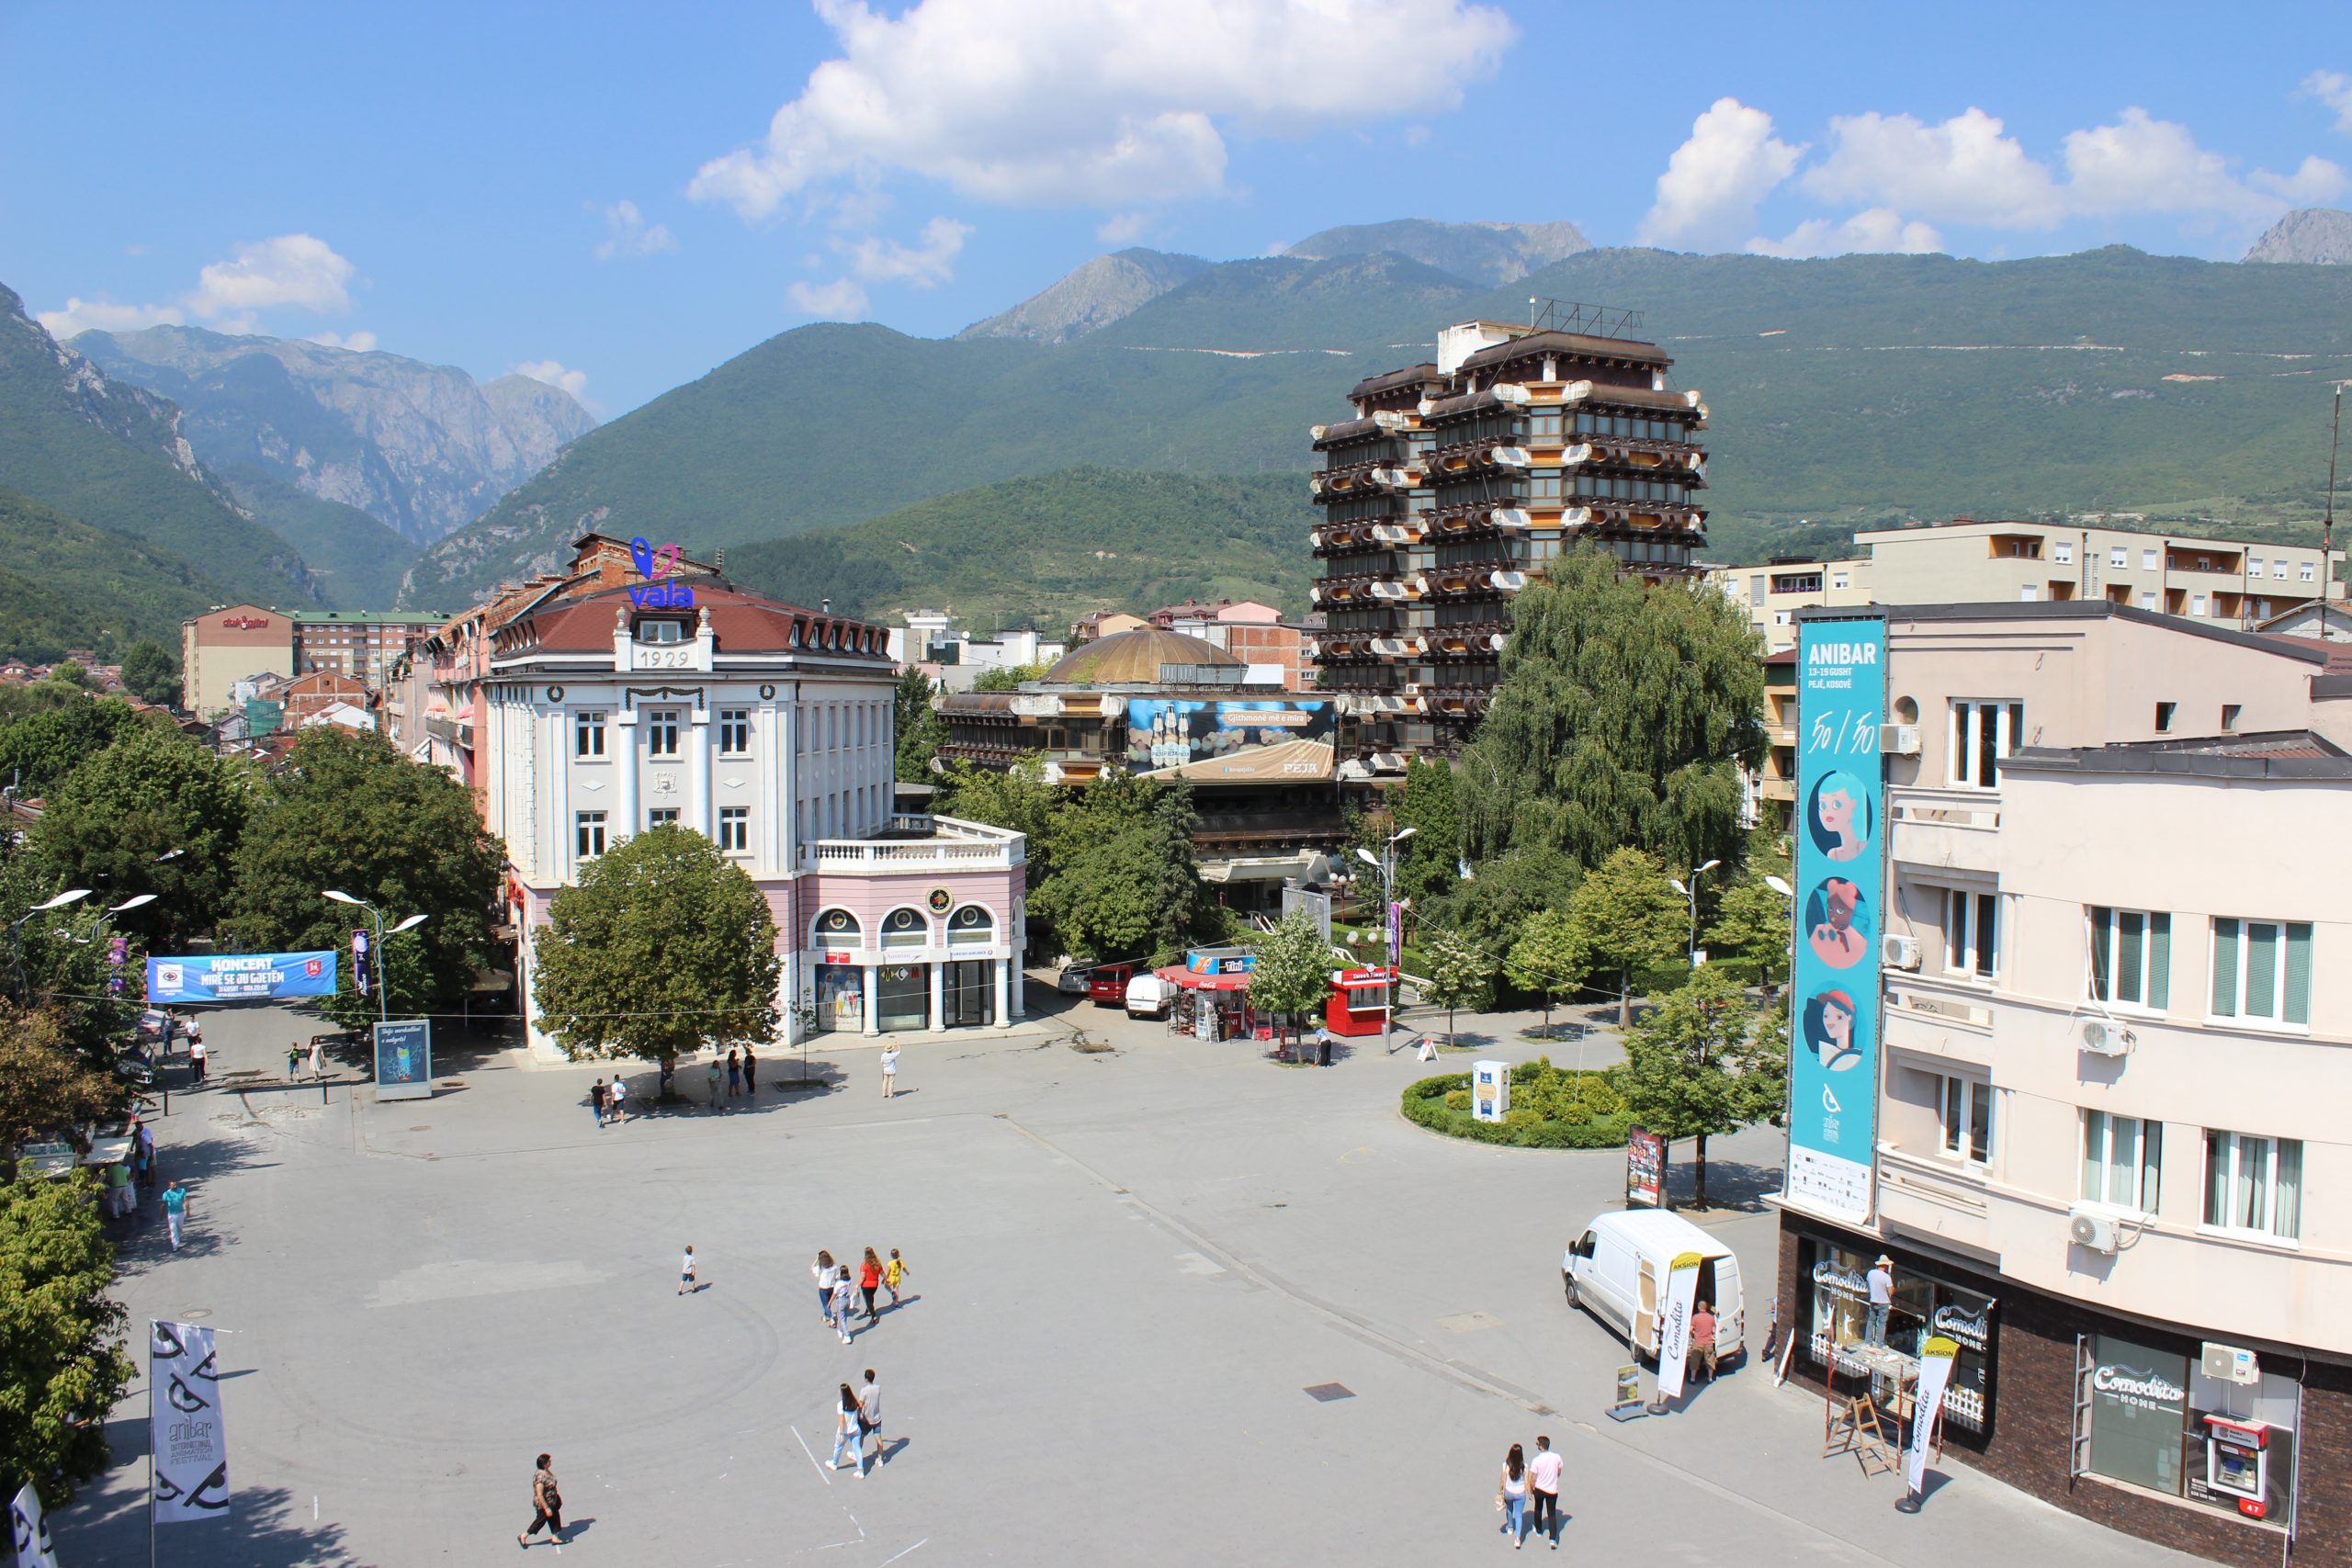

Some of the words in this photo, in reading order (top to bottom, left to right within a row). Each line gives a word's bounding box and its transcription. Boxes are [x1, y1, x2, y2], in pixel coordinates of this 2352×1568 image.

[628, 579, 695, 607] vala
[640, 651, 688, 668] 1929
[1808, 642, 1876, 665] ANIBAR
[1808, 668, 1828, 676] 13-19
[1829, 667, 1852, 676] GUSHT
[1227, 714, 1267, 723] Gjithmonë
[1283, 763, 1317, 773] PEJA
[210, 957, 274, 972] KONCERT
[1225, 961, 1243, 972] Tini
[201, 971, 223, 986] MIRË
[224, 973, 235, 985] SE
[1198, 981, 1216, 989] Coca-Cola
[1673, 1260, 1700, 1270] AKSION
[1813, 1260, 1869, 1293] Comodita
[1830, 1286, 1854, 1302] HOME
[1667, 1300, 1683, 1360] Comodita
[1954, 1334, 1983, 1351] HOME
[1925, 1348, 1954, 1357] AKSION
[2094, 1365, 2184, 1402] Comodita
[2120, 1393, 2156, 1411] HOME
[169, 1415, 212, 1441] anibar
[1911, 1388, 1929, 1453] Comodita
[170, 1453, 213, 1465] FESTIVAL
